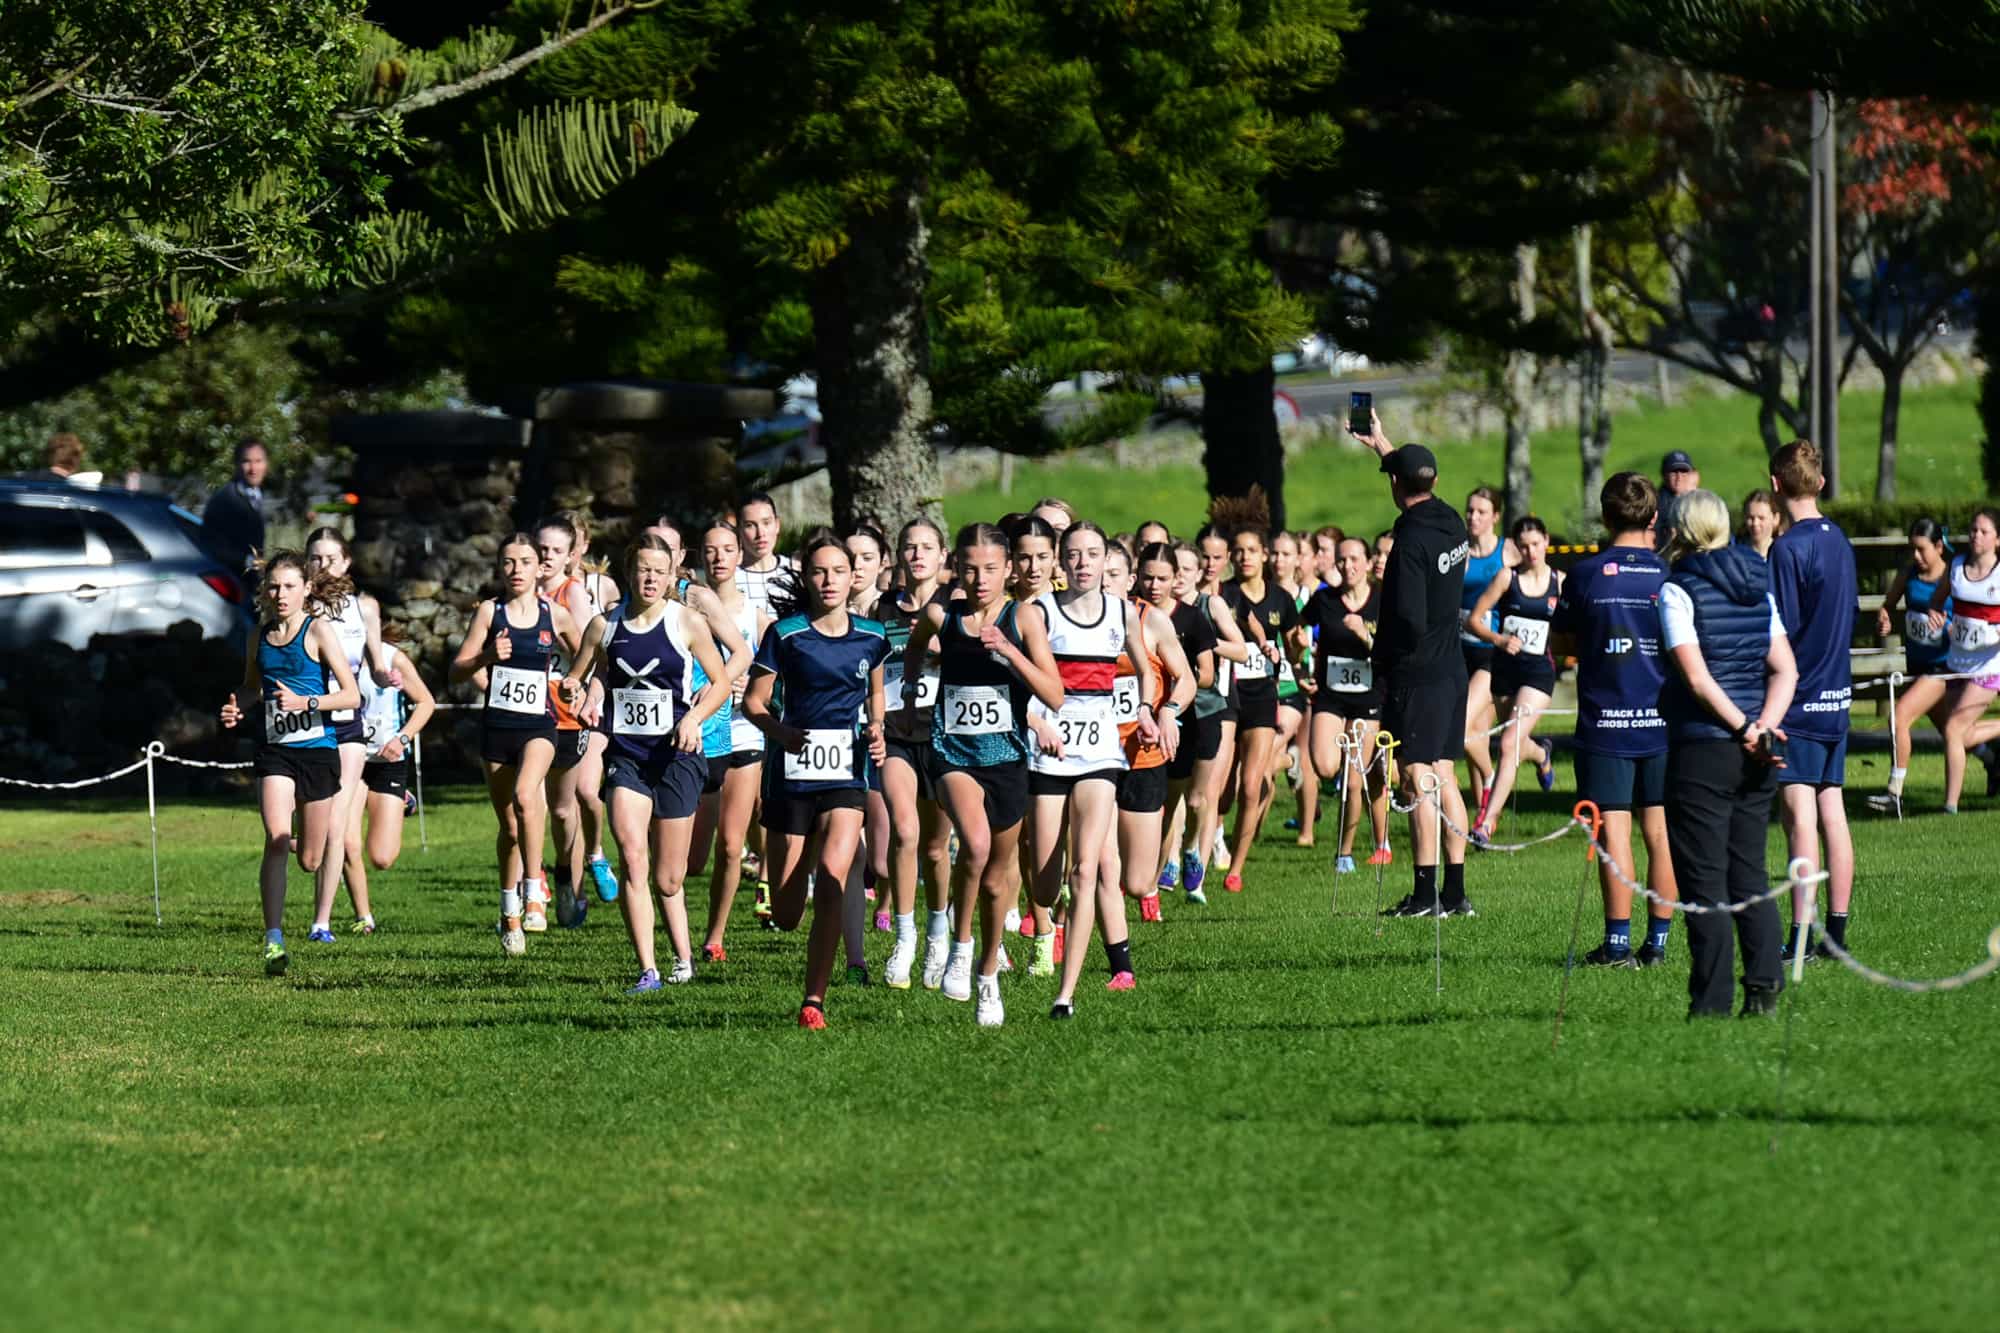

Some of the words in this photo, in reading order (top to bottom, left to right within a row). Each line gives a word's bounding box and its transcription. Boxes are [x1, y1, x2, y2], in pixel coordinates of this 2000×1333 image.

[1956, 623, 1978, 644] 374
[1604, 638, 1633, 654] JIP
[1339, 668, 1361, 685] 36
[500, 680, 537, 705] 456
[624, 702, 660, 726] 381
[954, 701, 1000, 726] 295
[1601, 709, 1634, 718] TRACK
[1636, 708, 1644, 717] &
[1803, 702, 1839, 712] CROSS
[274, 710, 312, 735] 600
[1058, 720, 1100, 746] 378
[1597, 719, 1629, 728] CROSS
[797, 744, 841, 770] 400
